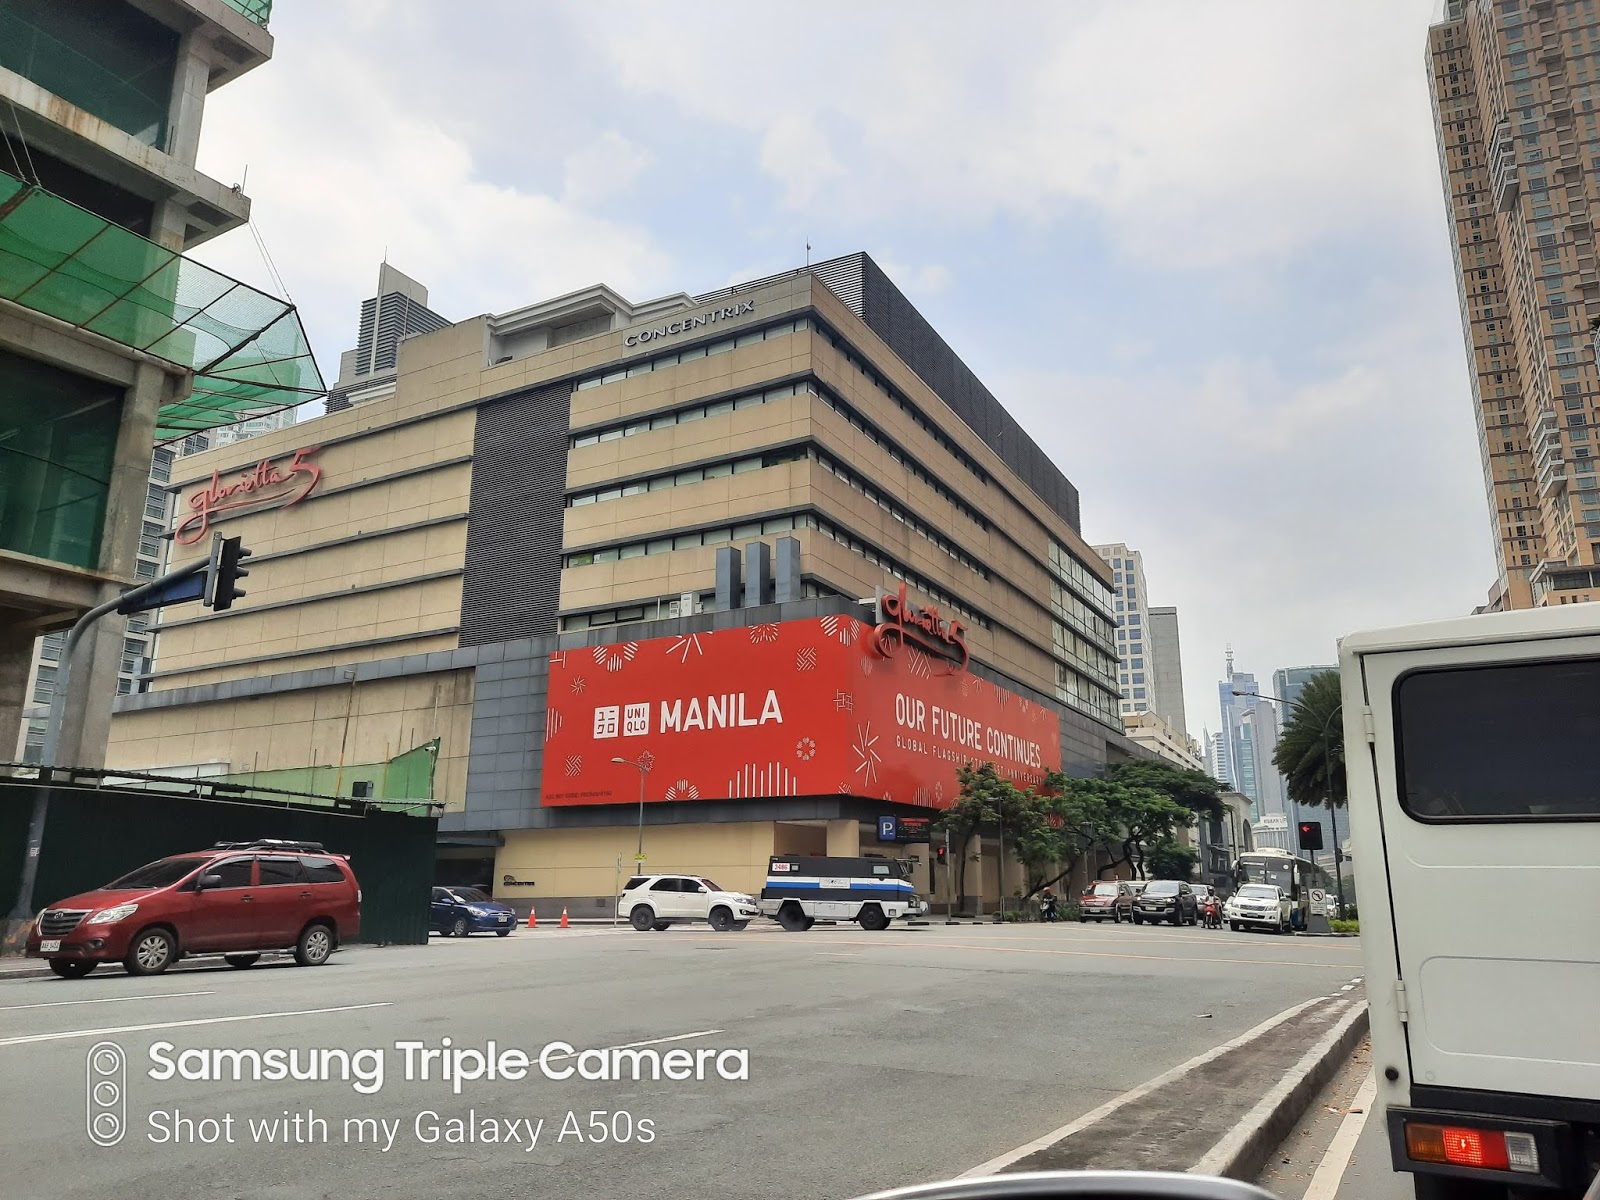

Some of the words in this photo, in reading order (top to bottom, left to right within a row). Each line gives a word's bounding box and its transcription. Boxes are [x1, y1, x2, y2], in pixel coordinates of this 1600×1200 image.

[624, 300, 755, 348] CONCENTRIX
[174, 459, 296, 546] glorietta
[286, 446, 325, 508] 5
[660, 689, 783, 734] MANILA
[895, 692, 926, 732] OUR
[931, 705, 982, 750] FUTURE
[986, 727, 1041, 768] CONTINUES
[896, 735, 928, 755] GLOBAL
